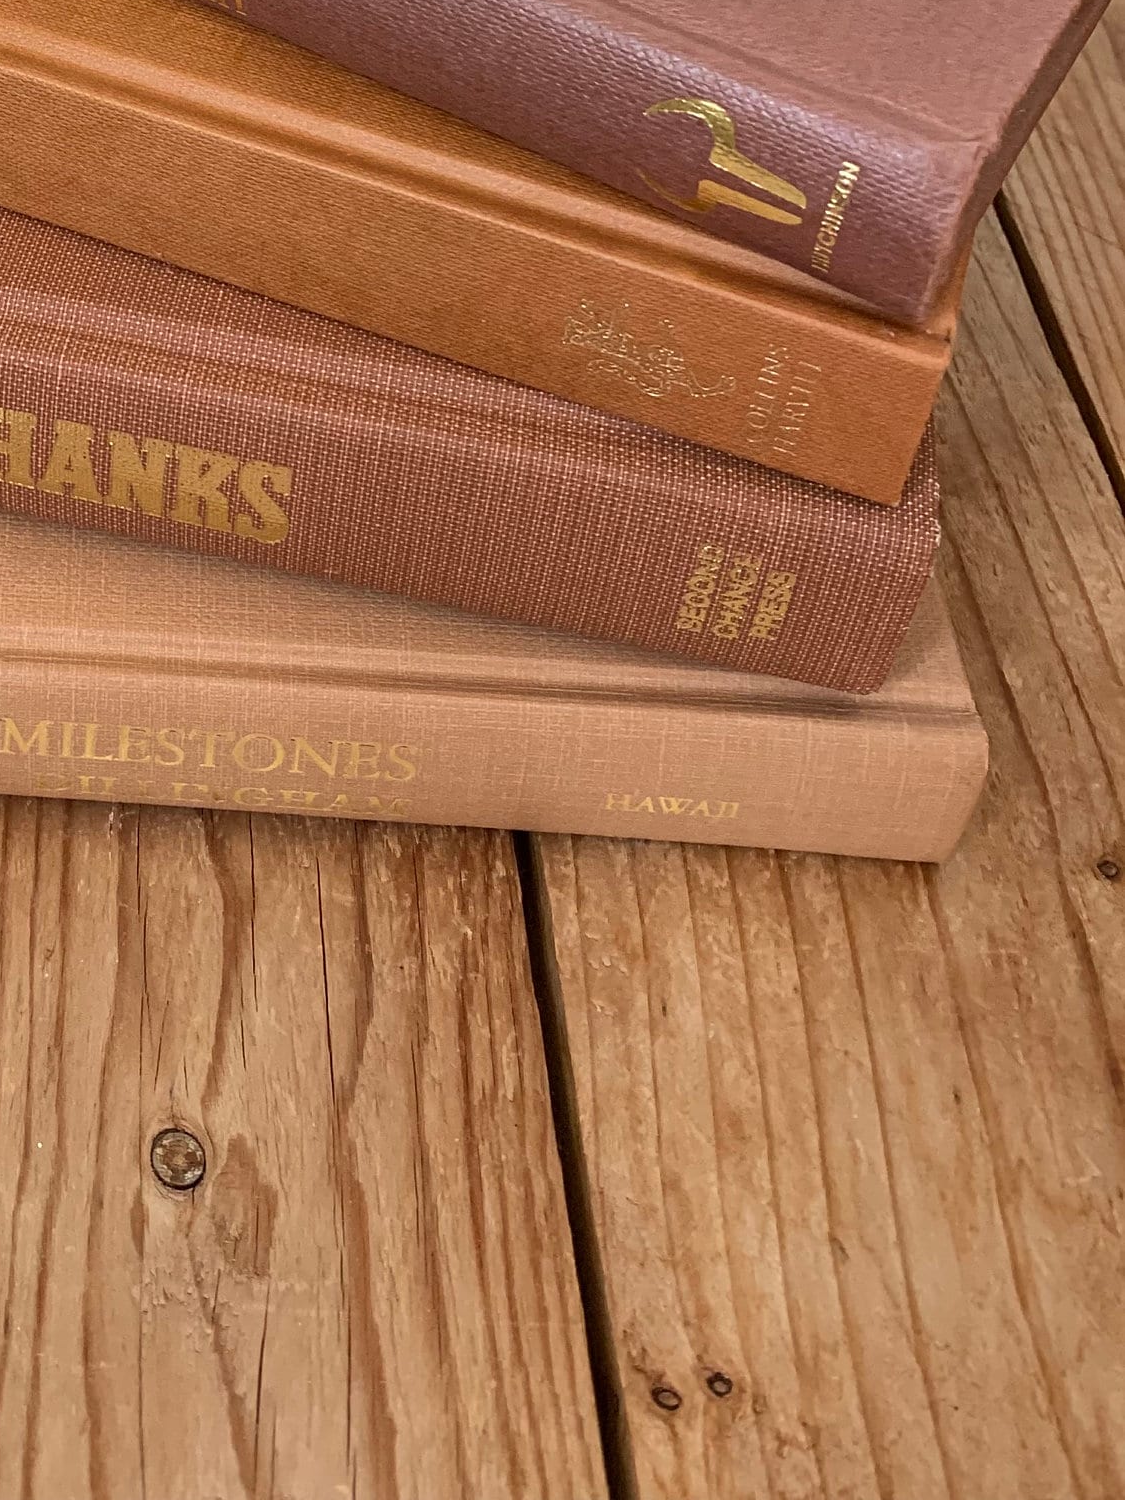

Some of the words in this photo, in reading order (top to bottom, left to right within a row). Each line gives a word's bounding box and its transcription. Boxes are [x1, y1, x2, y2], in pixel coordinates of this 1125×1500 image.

[810, 160, 861, 274] HUTCHINSON
[676, 544, 725, 633] SECOND
[748, 570, 797, 641] PRESS
[0, 717, 418, 782] MILESTONES
